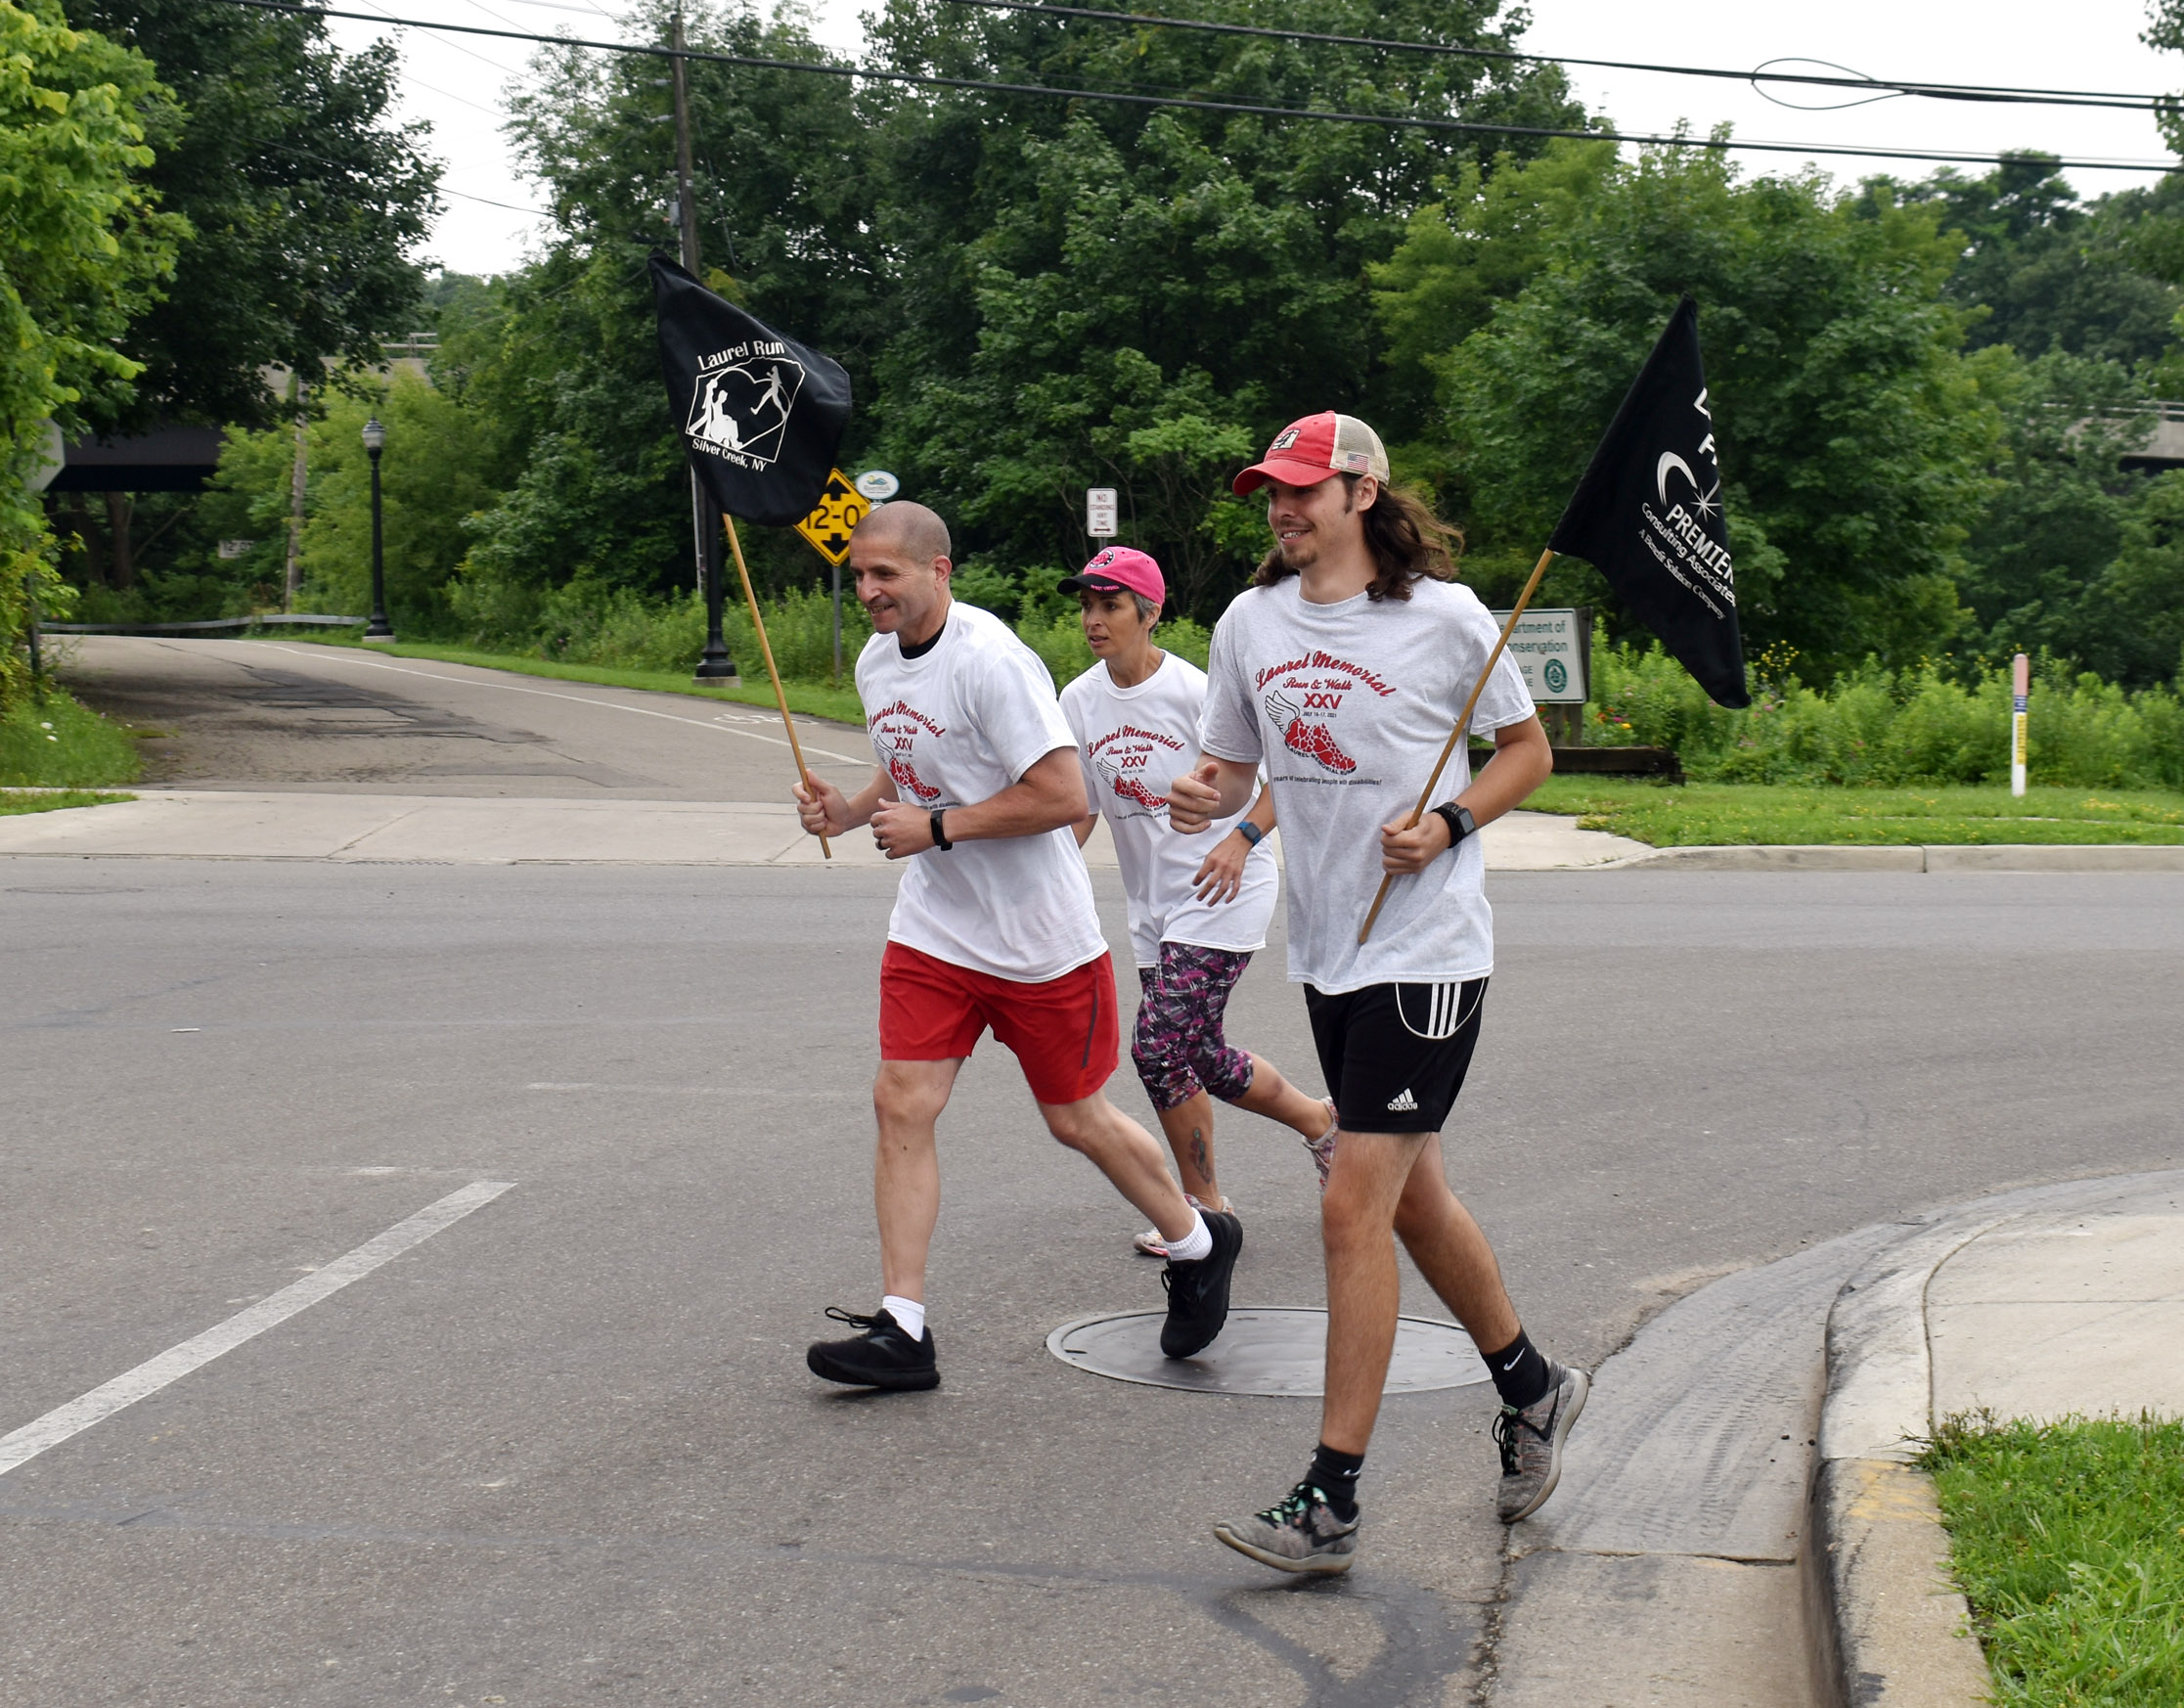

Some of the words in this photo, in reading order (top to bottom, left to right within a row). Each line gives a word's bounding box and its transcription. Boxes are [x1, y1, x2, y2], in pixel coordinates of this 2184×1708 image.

[697, 341, 749, 371] Laurel
[752, 340, 785, 355] Run
[691, 438, 722, 457] Silver
[722, 447, 749, 469] Creek,
[751, 459, 768, 472] NY
[1096, 493, 1108, 502] NO
[1642, 502, 1688, 559] Consulting
[1638, 528, 1646, 539] A
[1644, 534, 1667, 563] Benefit
[1664, 558, 1693, 589] Solution
[1692, 584, 1726, 620] Company
[1499, 621, 1553, 634] eartment
[1555, 620, 1566, 633] of
[1506, 638, 1569, 653] onservation
[1256, 652, 1311, 692] Laurel
[1312, 651, 1397, 697] Memorial
[1283, 677, 1309, 689] Run
[1311, 679, 1322, 690] &
[1324, 678, 1353, 691] Walk
[1303, 693, 1343, 709] XXV
[869, 701, 896, 735] Laurel
[896, 700, 946, 738] Memorial
[881, 723, 896, 734] Run
[894, 737, 914, 751] XXV
[1088, 727, 1121, 759] Laurel
[1122, 725, 1185, 751] Memorial
[1106, 746, 1123, 756] Run
[1133, 743, 1154, 753] Walk
[1121, 755, 1147, 769] XXV
[1286, 744, 1311, 758] LAUREL
[1311, 752, 1339, 775] MEMORIAL
[1387, 1101, 1418, 1111] adidas
